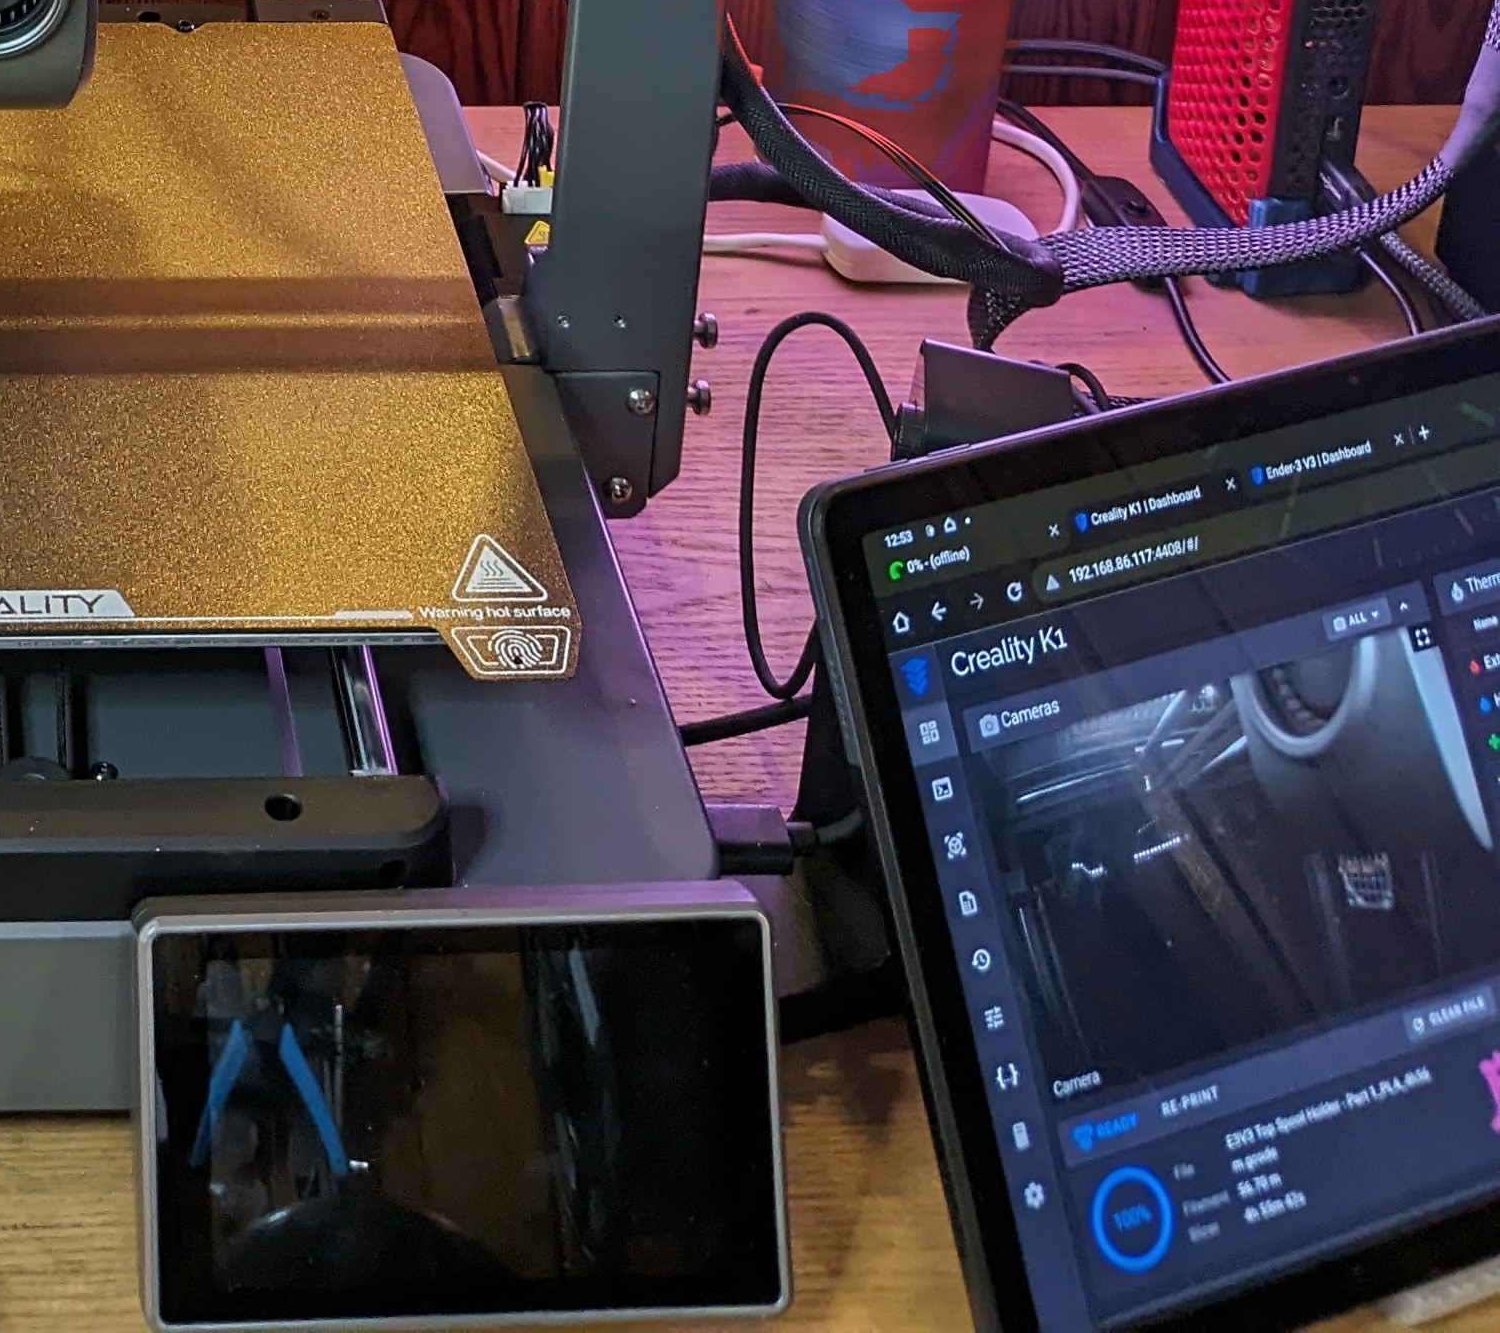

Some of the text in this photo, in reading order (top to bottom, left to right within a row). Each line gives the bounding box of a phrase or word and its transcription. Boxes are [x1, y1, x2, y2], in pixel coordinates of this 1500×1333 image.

[1266, 459, 1302, 479] Ender-3
[1302, 453, 1316, 471] V3
[1322, 440, 1372, 465] Dashboard
[1090, 503, 1128, 526] Creality
[1128, 494, 1143, 516] K1
[1148, 485, 1201, 511] Dashboard
[884, 530, 913, 548] 12:53
[906, 555, 924, 574] 0%
[930, 545, 970, 569] (offline)
[419, 605, 570, 620] Warning hot surface
[1349, 611, 1367, 627] ALL
[952, 626, 1068, 676] Creality K1
[1001, 700, 1060, 727] Cameras
[1053, 1070, 1101, 1098] Camera
[1160, 1085, 1218, 1117] RE-PRINT
[1096, 1113, 1138, 1139] READY
